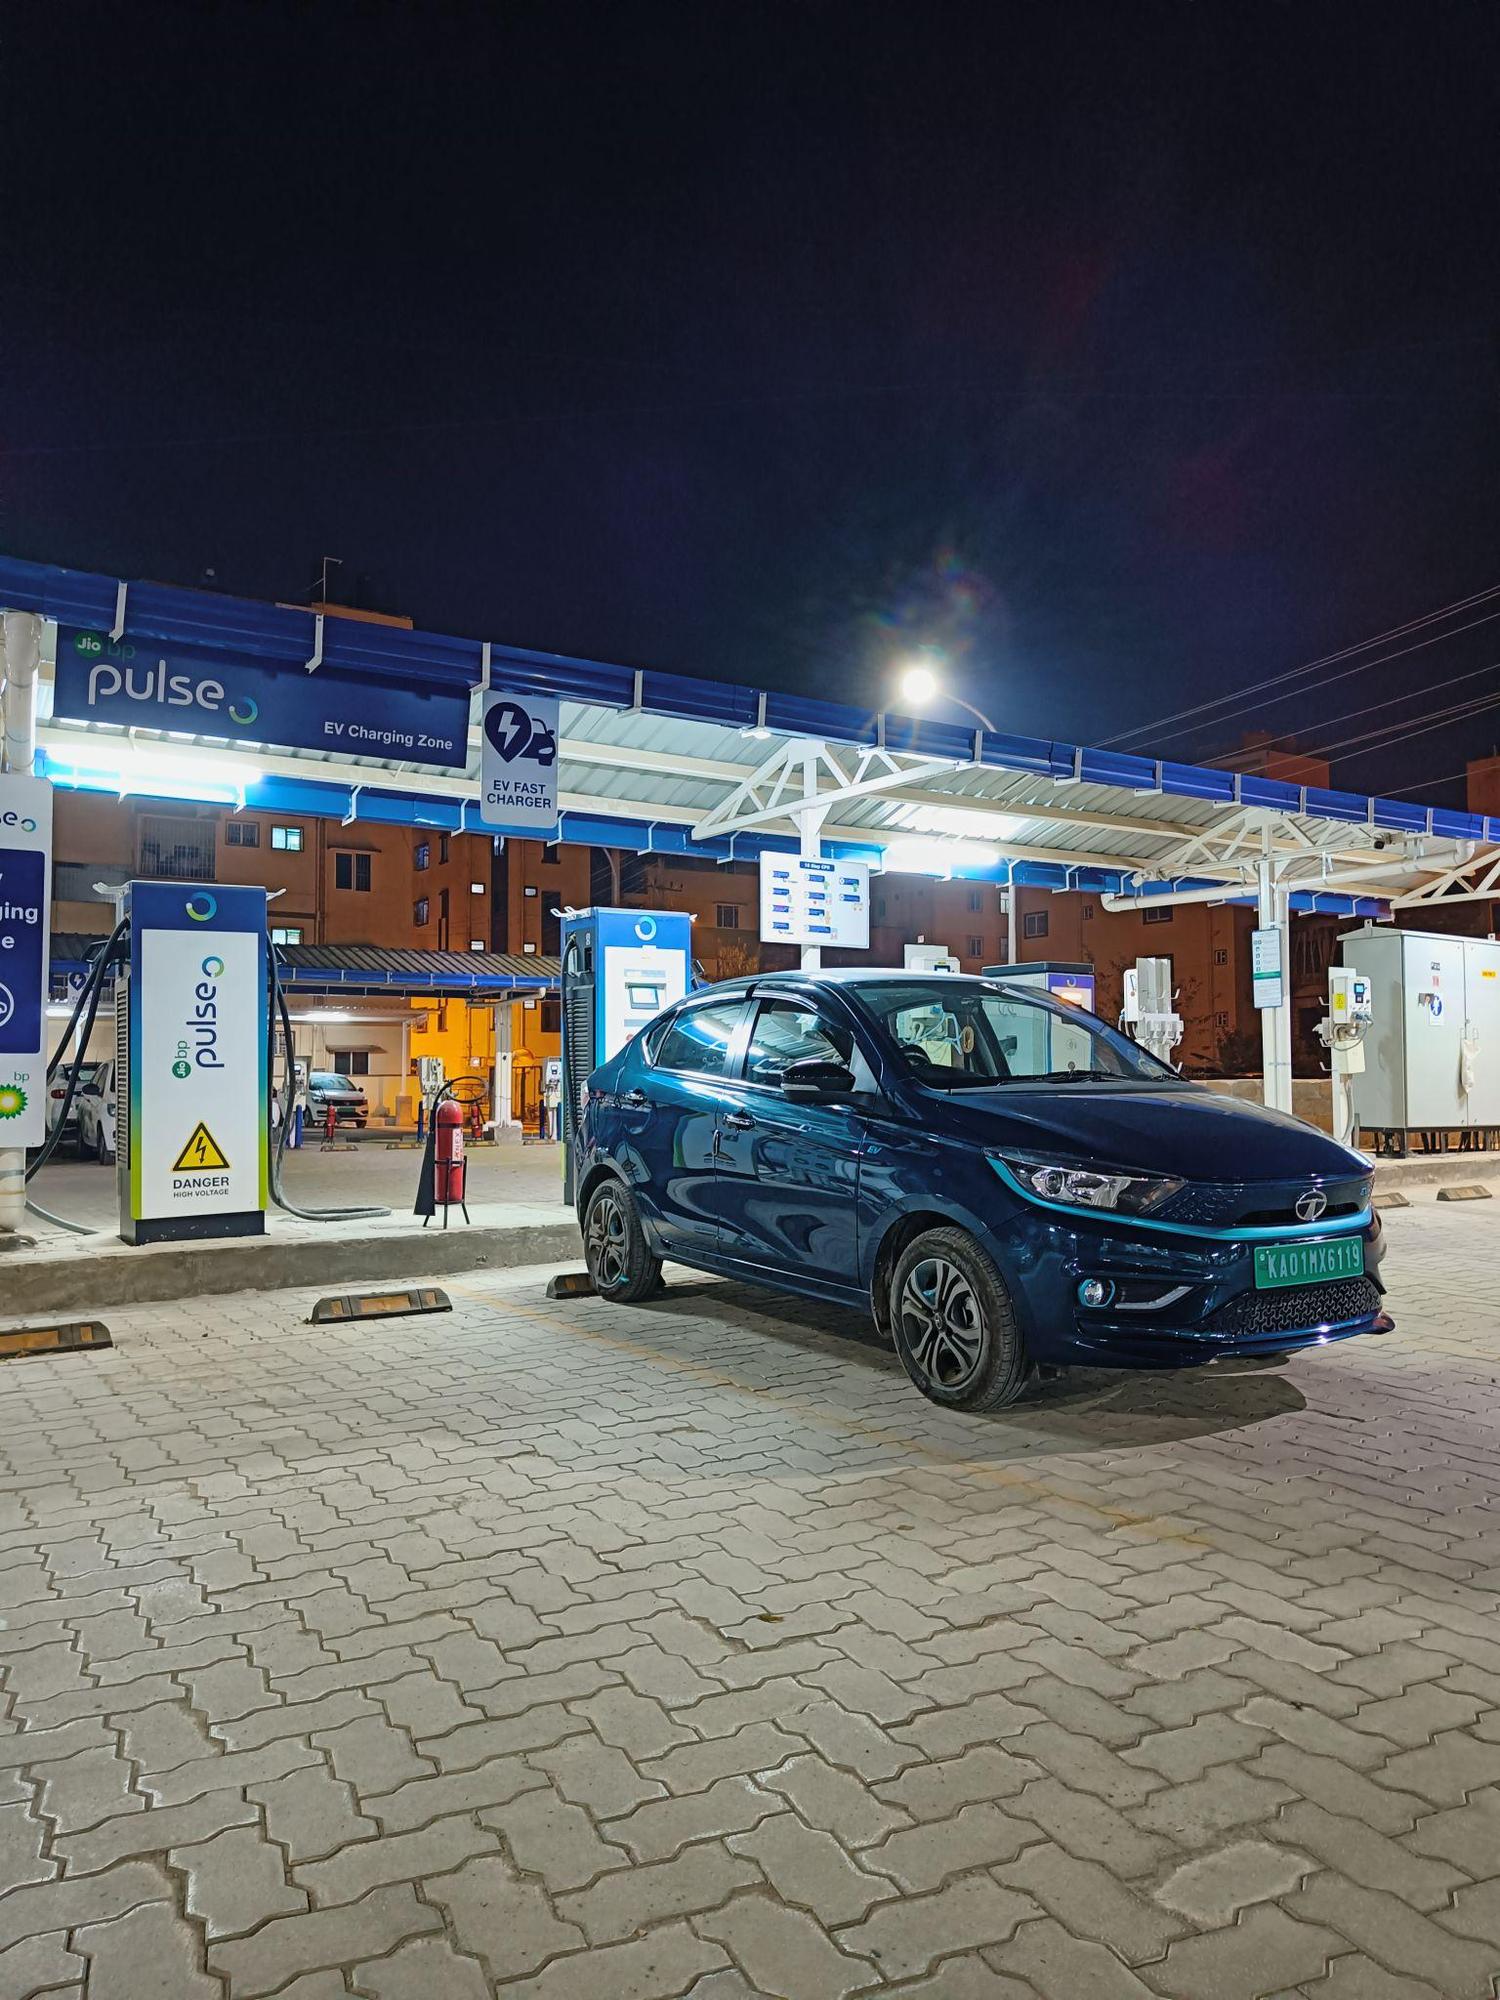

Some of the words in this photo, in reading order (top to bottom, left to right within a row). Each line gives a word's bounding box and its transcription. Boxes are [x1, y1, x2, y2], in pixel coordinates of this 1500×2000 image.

[77, 637, 102, 652] Jio
[88, 659, 225, 710] pulse
[324, 721, 345, 735] EV
[348, 724, 414, 748] Charging
[417, 734, 453, 750] Zone
[493, 779, 511, 791] EV
[514, 781, 547, 795] FAST
[486, 792, 552, 809] CHARGER
[186, 982, 225, 1068] pulse
[174, 1040, 190, 1059] bp
[13, 1071, 30, 1083] bp
[173, 1176, 230, 1190] DANGER
[173, 1190, 193, 1199] HIGH
[194, 1188, 229, 1197] VOLTAGE
[1267, 1243, 1360, 1279] KA01MX6119
